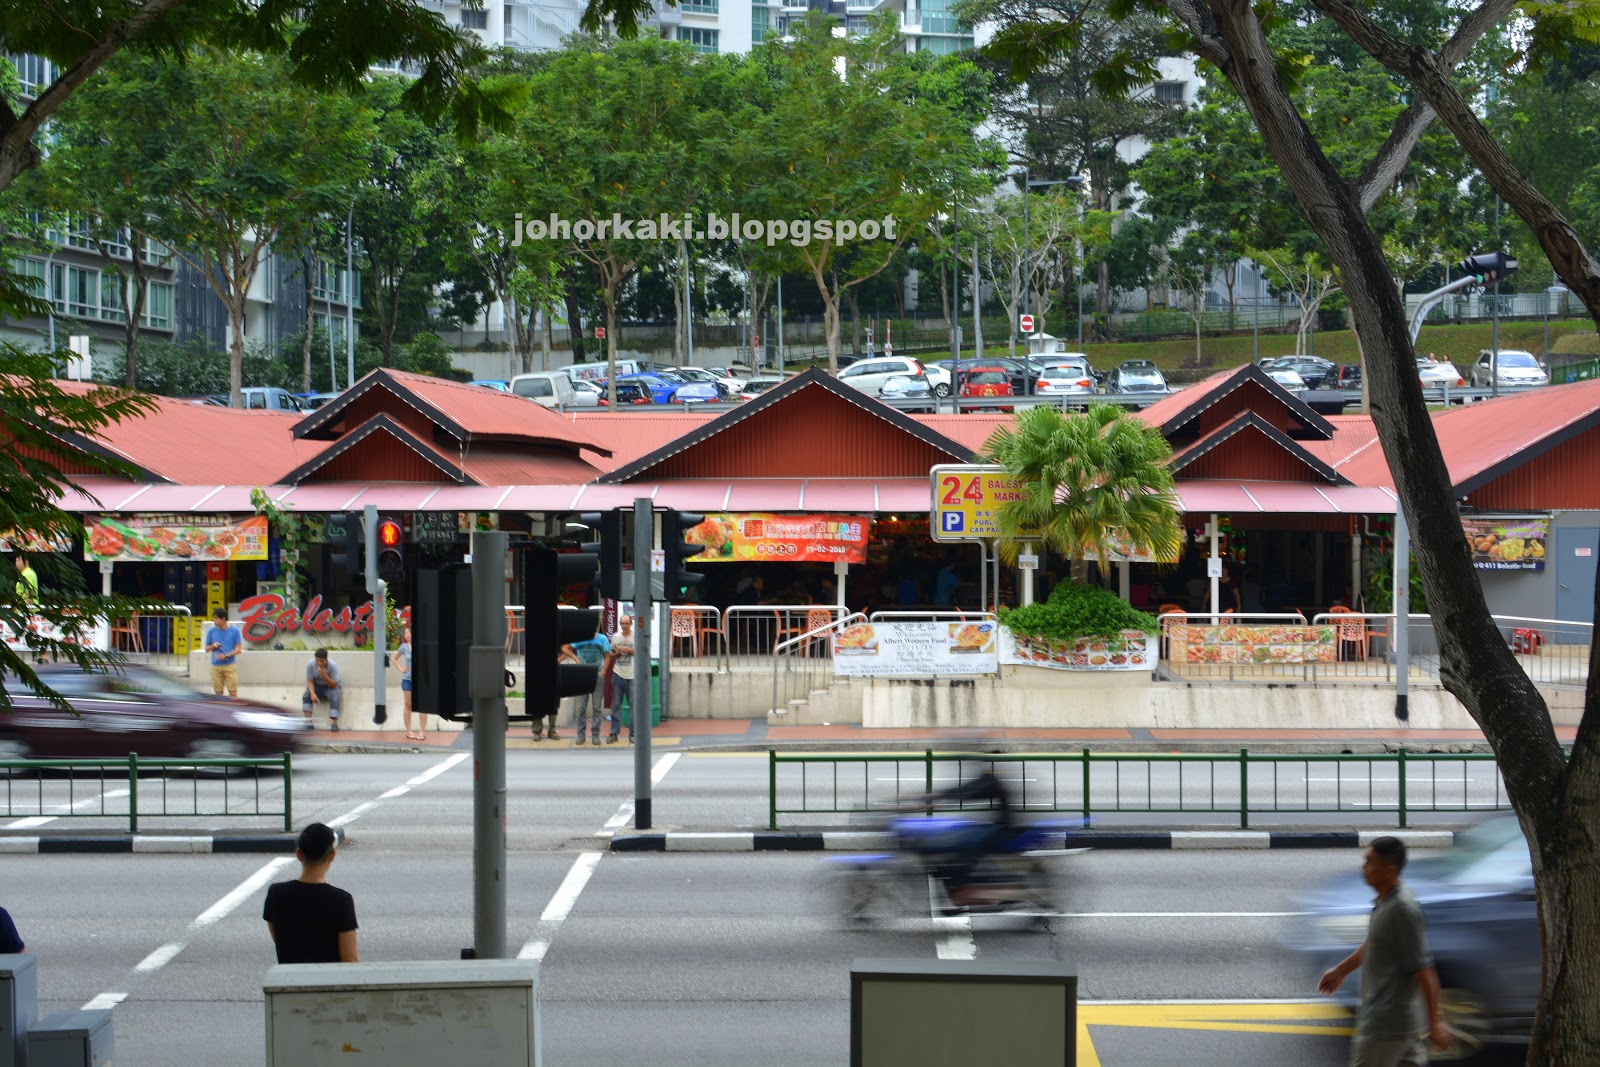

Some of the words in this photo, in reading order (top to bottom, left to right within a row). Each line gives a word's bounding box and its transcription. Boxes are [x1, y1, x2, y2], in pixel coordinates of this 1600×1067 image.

[942, 476, 984, 504] 24
[988, 480, 1028, 488] BALEST
[946, 513, 960, 530] P
